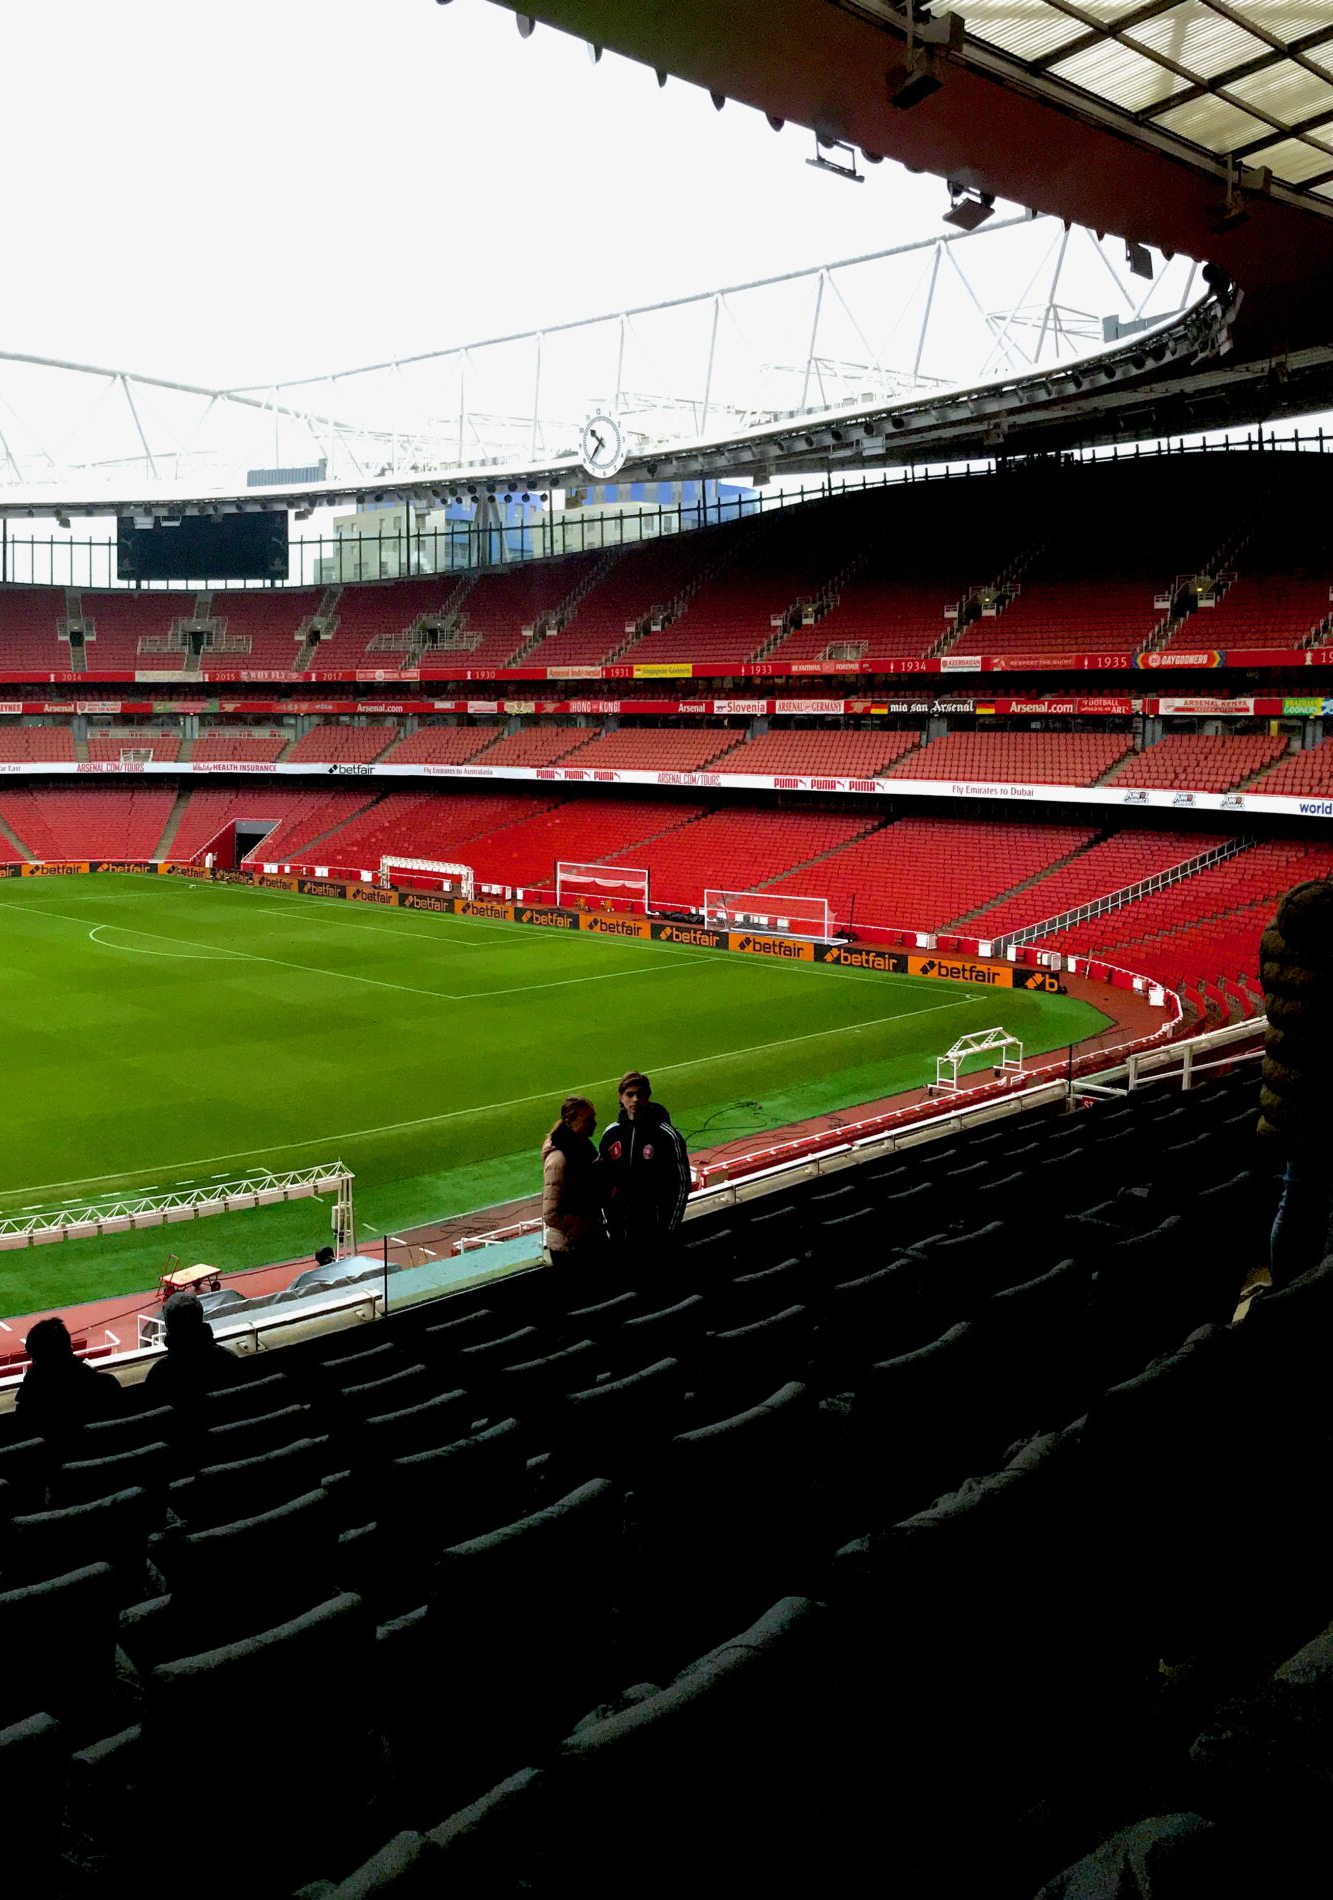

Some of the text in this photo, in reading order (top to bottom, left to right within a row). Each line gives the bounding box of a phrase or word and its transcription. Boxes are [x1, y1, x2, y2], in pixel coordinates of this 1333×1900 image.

[901, 660, 927, 672] 1934
[1096, 656, 1128, 668] 1935
[476, 670, 496, 680] 1930
[611, 668, 630, 678] 1931
[750, 665, 773, 675] 1933
[62, 672, 83, 681] 2014
[215, 672, 236, 681] 2015
[322, 672, 343, 681] 2017
[43, 703, 74, 713] Arsenal
[356, 703, 404, 714] Arsenal.com
[678, 703, 706, 713] Arsenal
[727, 701, 766, 713] Slovenia
[777, 701, 843, 713] ARSENAL GERMANY
[930, 700, 975, 715] Arsenal
[1009, 701, 1074, 713] Arsenal.com
[213, 763, 278, 772] HEALTH INSURANCE
[338, 764, 377, 775] betfair
[536, 770, 614, 781] PUMA PUMA PUMA
[774, 777, 876, 792] PUMA PUMA PUMA
[952, 784, 964, 795] Fly
[966, 785, 998, 796] Emirates
[1011, 786, 1034, 797] Dubai
[41, 864, 82, 876] betfair
[106, 863, 149, 873] betfair
[265, 876, 293, 891] betfair
[311, 882, 343, 898] betfair
[359, 889, 394, 904] betfair
[413, 894, 450, 912] betfair
[471, 903, 509, 921] betfair
[532, 909, 574, 928] betfair
[598, 917, 643, 936] betfair
[671, 928, 720, 948] betfair
[752, 936, 805, 959] betfair
[839, 948, 898, 972] betfair
[937, 958, 1001, 984] betfair
